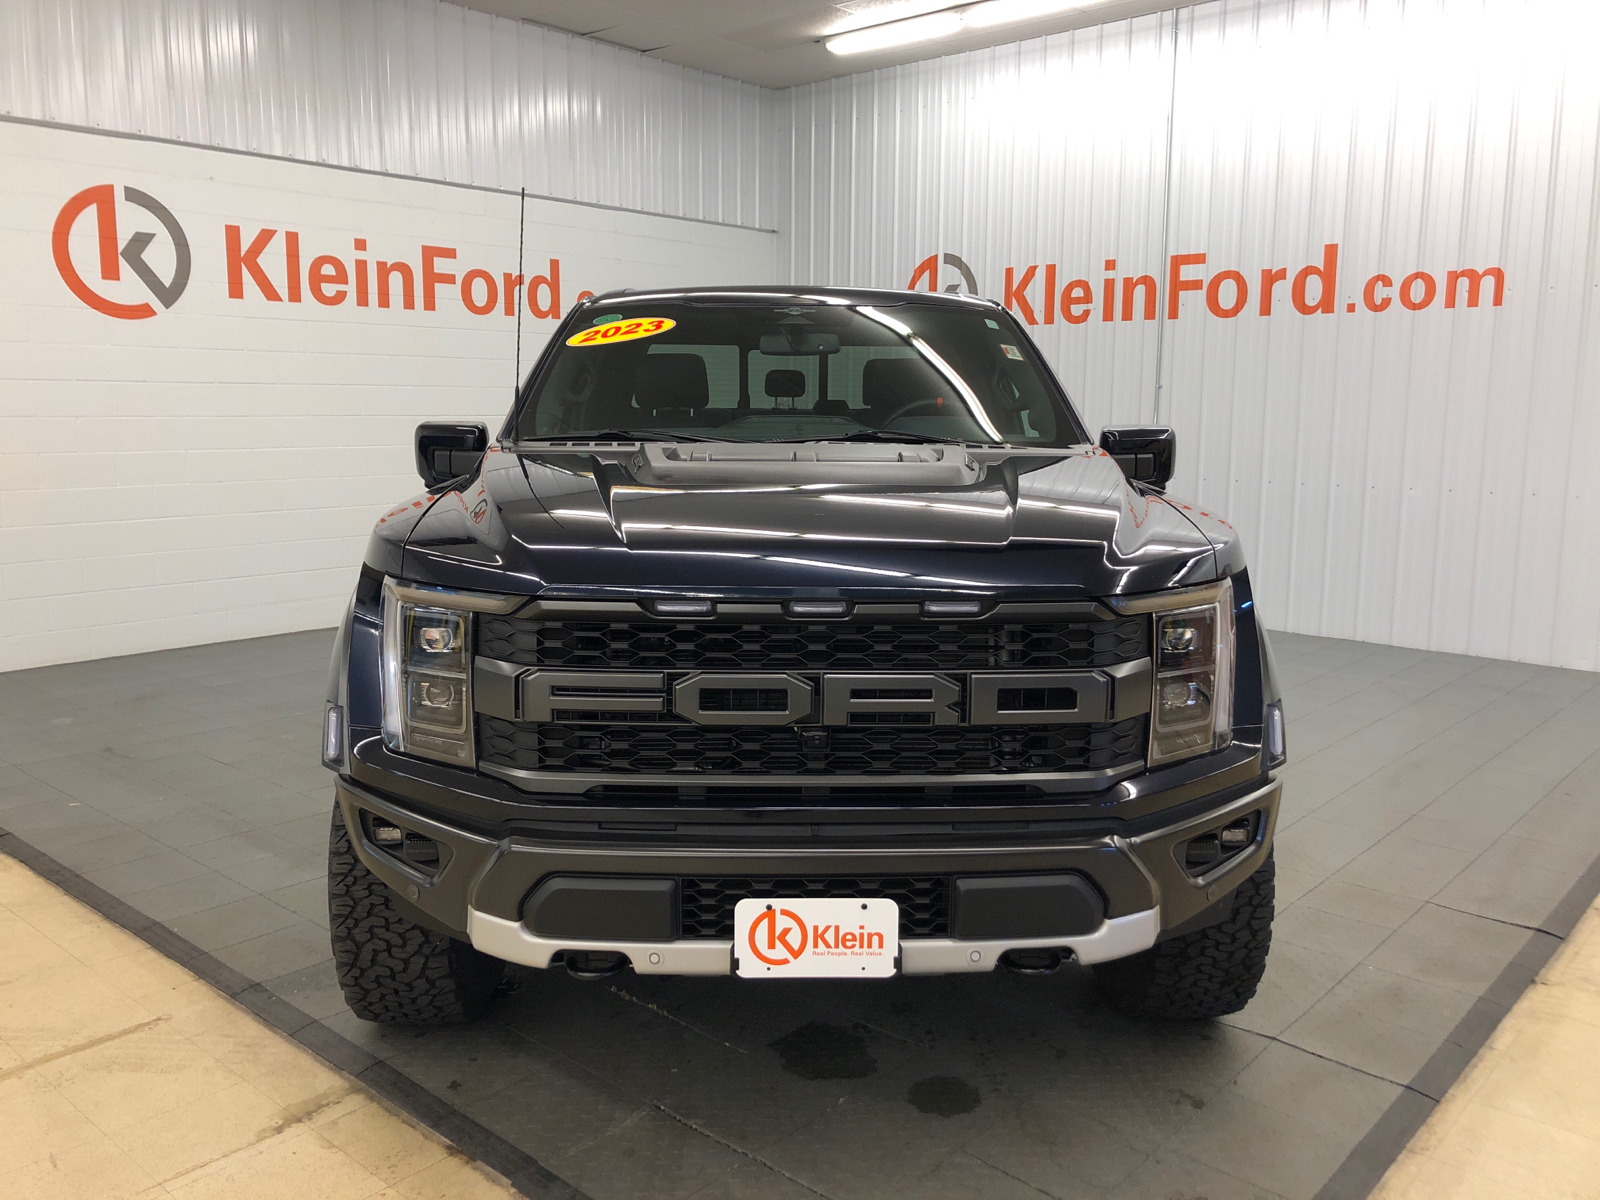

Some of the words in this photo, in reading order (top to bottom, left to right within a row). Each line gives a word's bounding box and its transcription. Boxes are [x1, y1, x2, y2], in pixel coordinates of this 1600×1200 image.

[224, 224, 595, 320] KleinFord
[1004, 243, 1506, 326] KleinFord.com
[577, 320, 665, 344] 2023
[521, 670, 1108, 727] FORD
[812, 925, 884, 950] Klein
